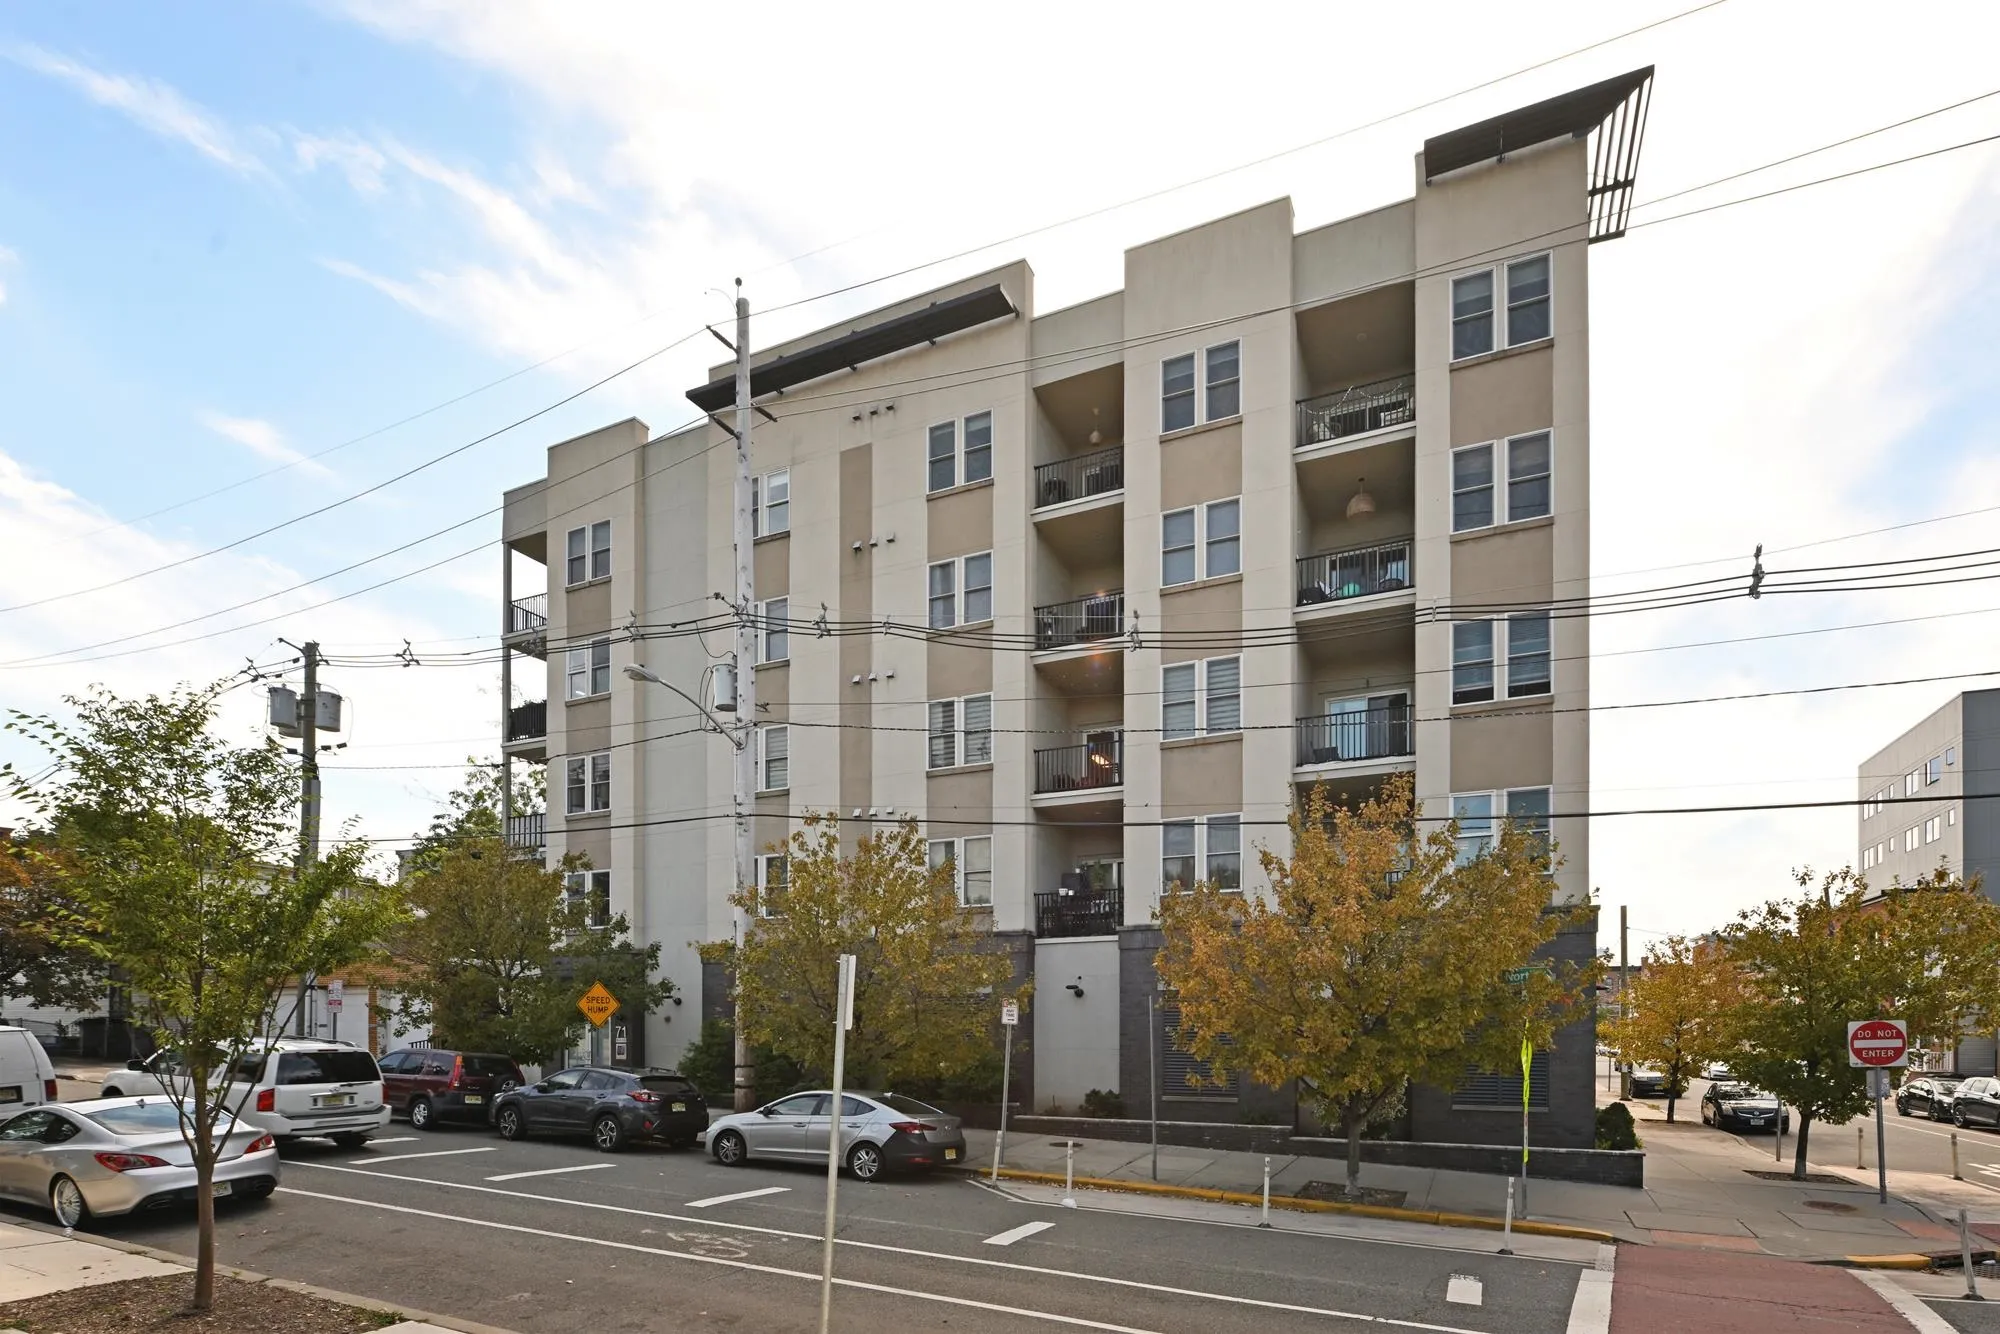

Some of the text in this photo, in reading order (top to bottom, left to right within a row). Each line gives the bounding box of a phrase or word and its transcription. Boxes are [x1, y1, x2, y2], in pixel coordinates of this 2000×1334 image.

[586, 996, 611, 1004] SPEED
[587, 1006, 609, 1014] HUMP
[615, 1026, 627, 1038] 71
[1857, 1029, 1897, 1038] DO NOT
[1862, 1049, 1895, 1058] ENTER
